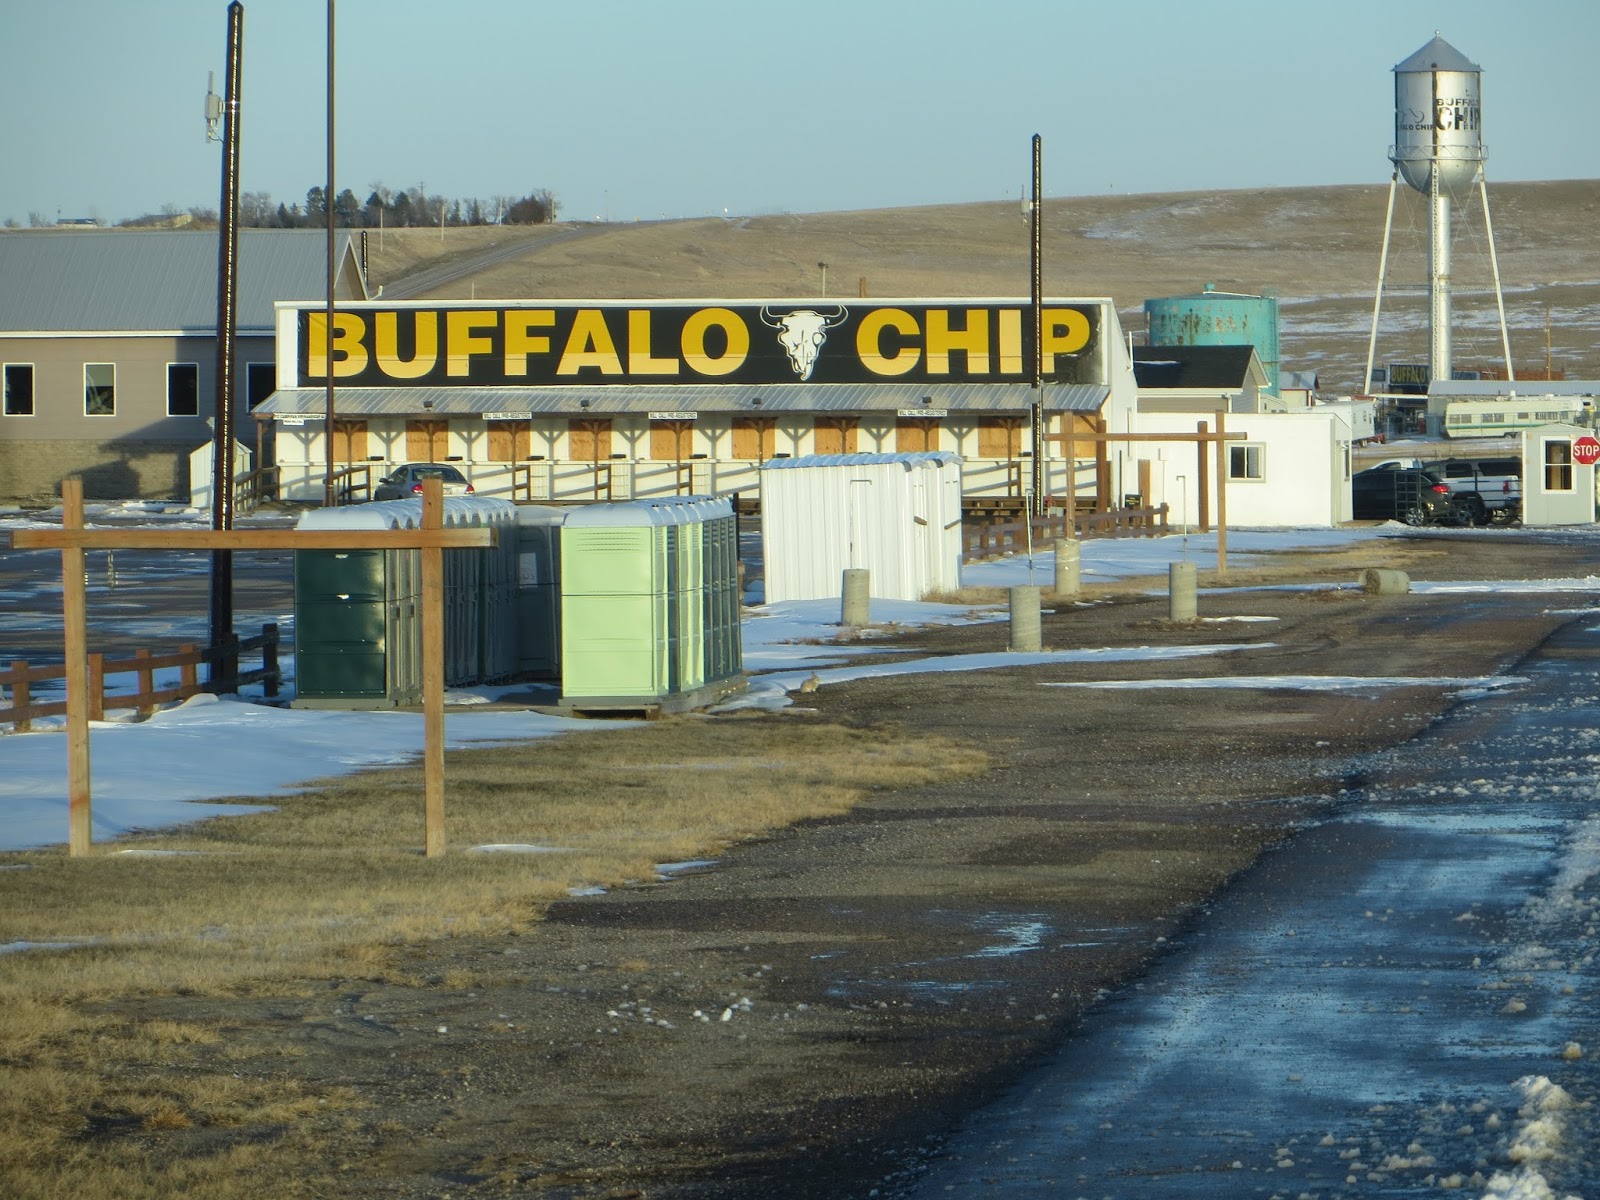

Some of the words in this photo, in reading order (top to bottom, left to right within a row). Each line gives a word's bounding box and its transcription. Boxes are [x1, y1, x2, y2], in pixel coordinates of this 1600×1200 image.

[308, 308, 750, 379] BUFFALO
[856, 307, 1091, 376] CHIP
[1391, 365, 1426, 383] BUFFALO
[1573, 445, 1599, 456] STOP
